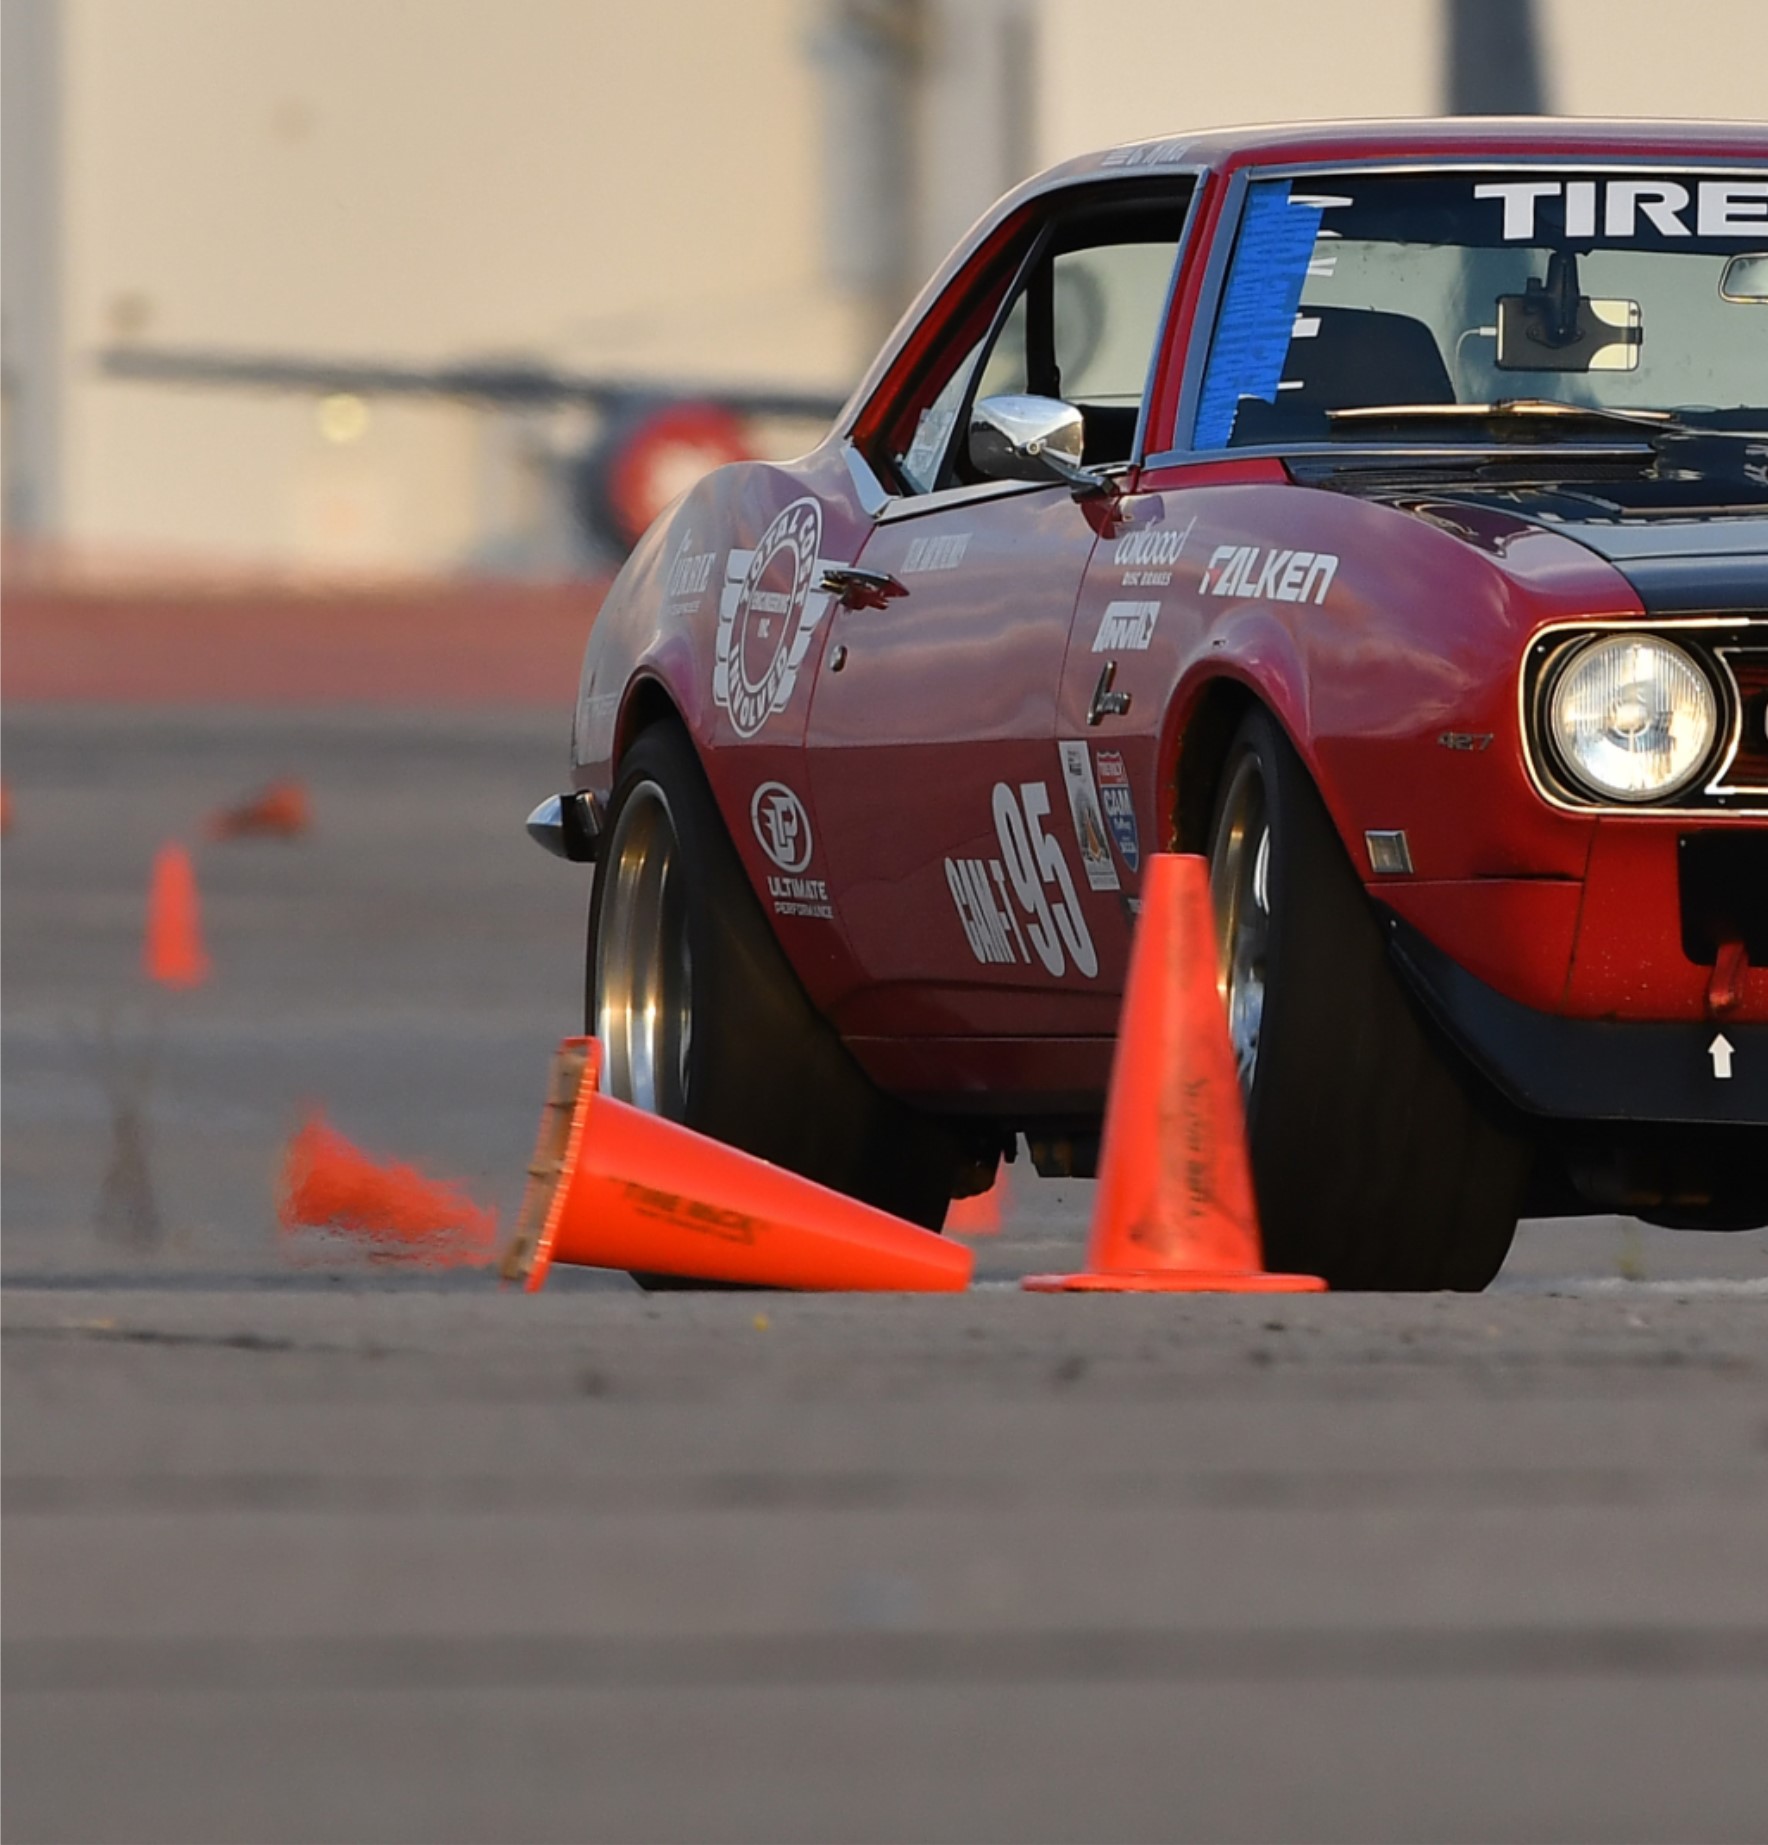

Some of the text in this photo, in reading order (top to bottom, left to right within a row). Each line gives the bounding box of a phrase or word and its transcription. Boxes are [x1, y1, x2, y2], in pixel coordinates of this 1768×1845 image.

[738, 507, 802, 604] TOTAL
[1198, 545, 1339, 606] FALKEN
[728, 645, 788, 727] INVOLVED
[1436, 731, 1495, 752] 427
[1103, 788, 1133, 818] CAM
[767, 876, 829, 901] ULTIMATE
[992, 781, 1099, 979] 95
[774, 901, 835, 920] PERFORMANCE
